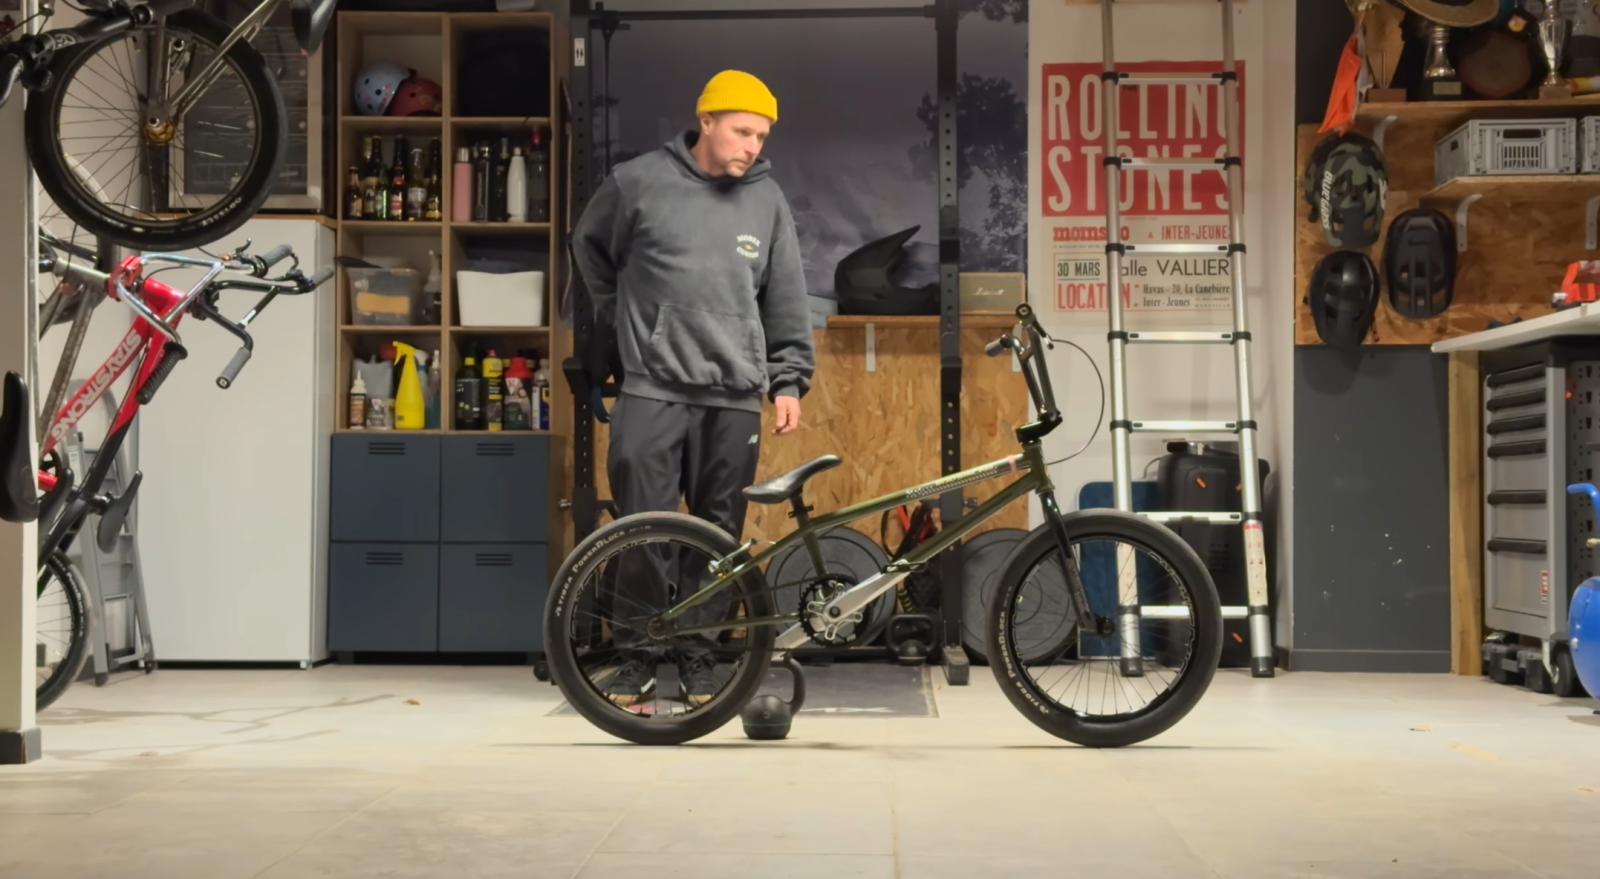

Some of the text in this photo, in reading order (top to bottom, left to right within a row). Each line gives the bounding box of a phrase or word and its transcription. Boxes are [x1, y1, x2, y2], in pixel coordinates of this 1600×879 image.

[1057, 262, 1101, 277] 30 MARS
[1121, 258, 1229, 276] alle VALLIER
[1143, 283, 1165, 294] Havas
[1184, 283, 1193, 294] La
[51, 328, 142, 439] STAYSTRONG
